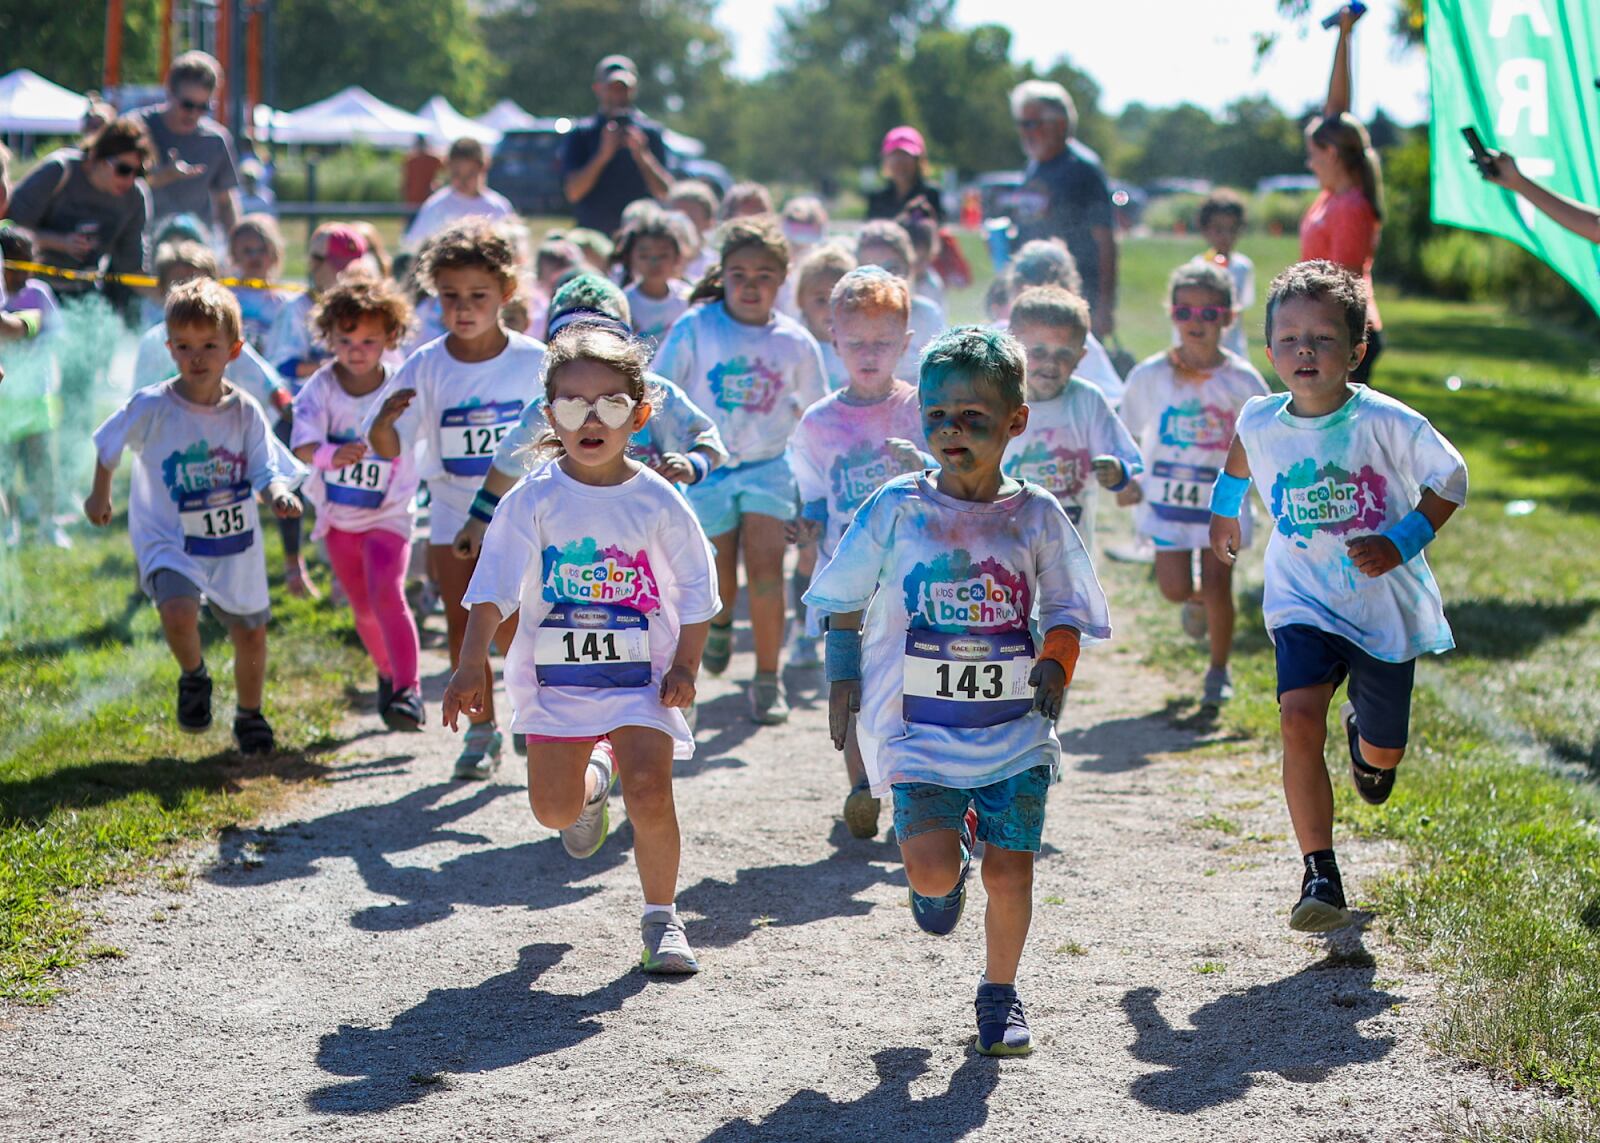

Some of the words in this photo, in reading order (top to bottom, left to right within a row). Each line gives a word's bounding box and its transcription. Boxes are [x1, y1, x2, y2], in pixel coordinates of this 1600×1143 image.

[337, 463, 380, 488] 149
[1163, 481, 1199, 505] 144
[1307, 481, 1356, 503] color
[203, 505, 245, 536] 135
[1297, 501, 1339, 521] bash
[581, 562, 635, 583] color
[568, 579, 614, 599] bash
[615, 587, 633, 596] RUN
[956, 579, 1011, 603] color
[940, 601, 995, 622] bash
[996, 607, 1015, 620] RUN
[562, 631, 621, 662] 141
[951, 645, 969, 653] RACE
[936, 664, 1003, 698] 143
